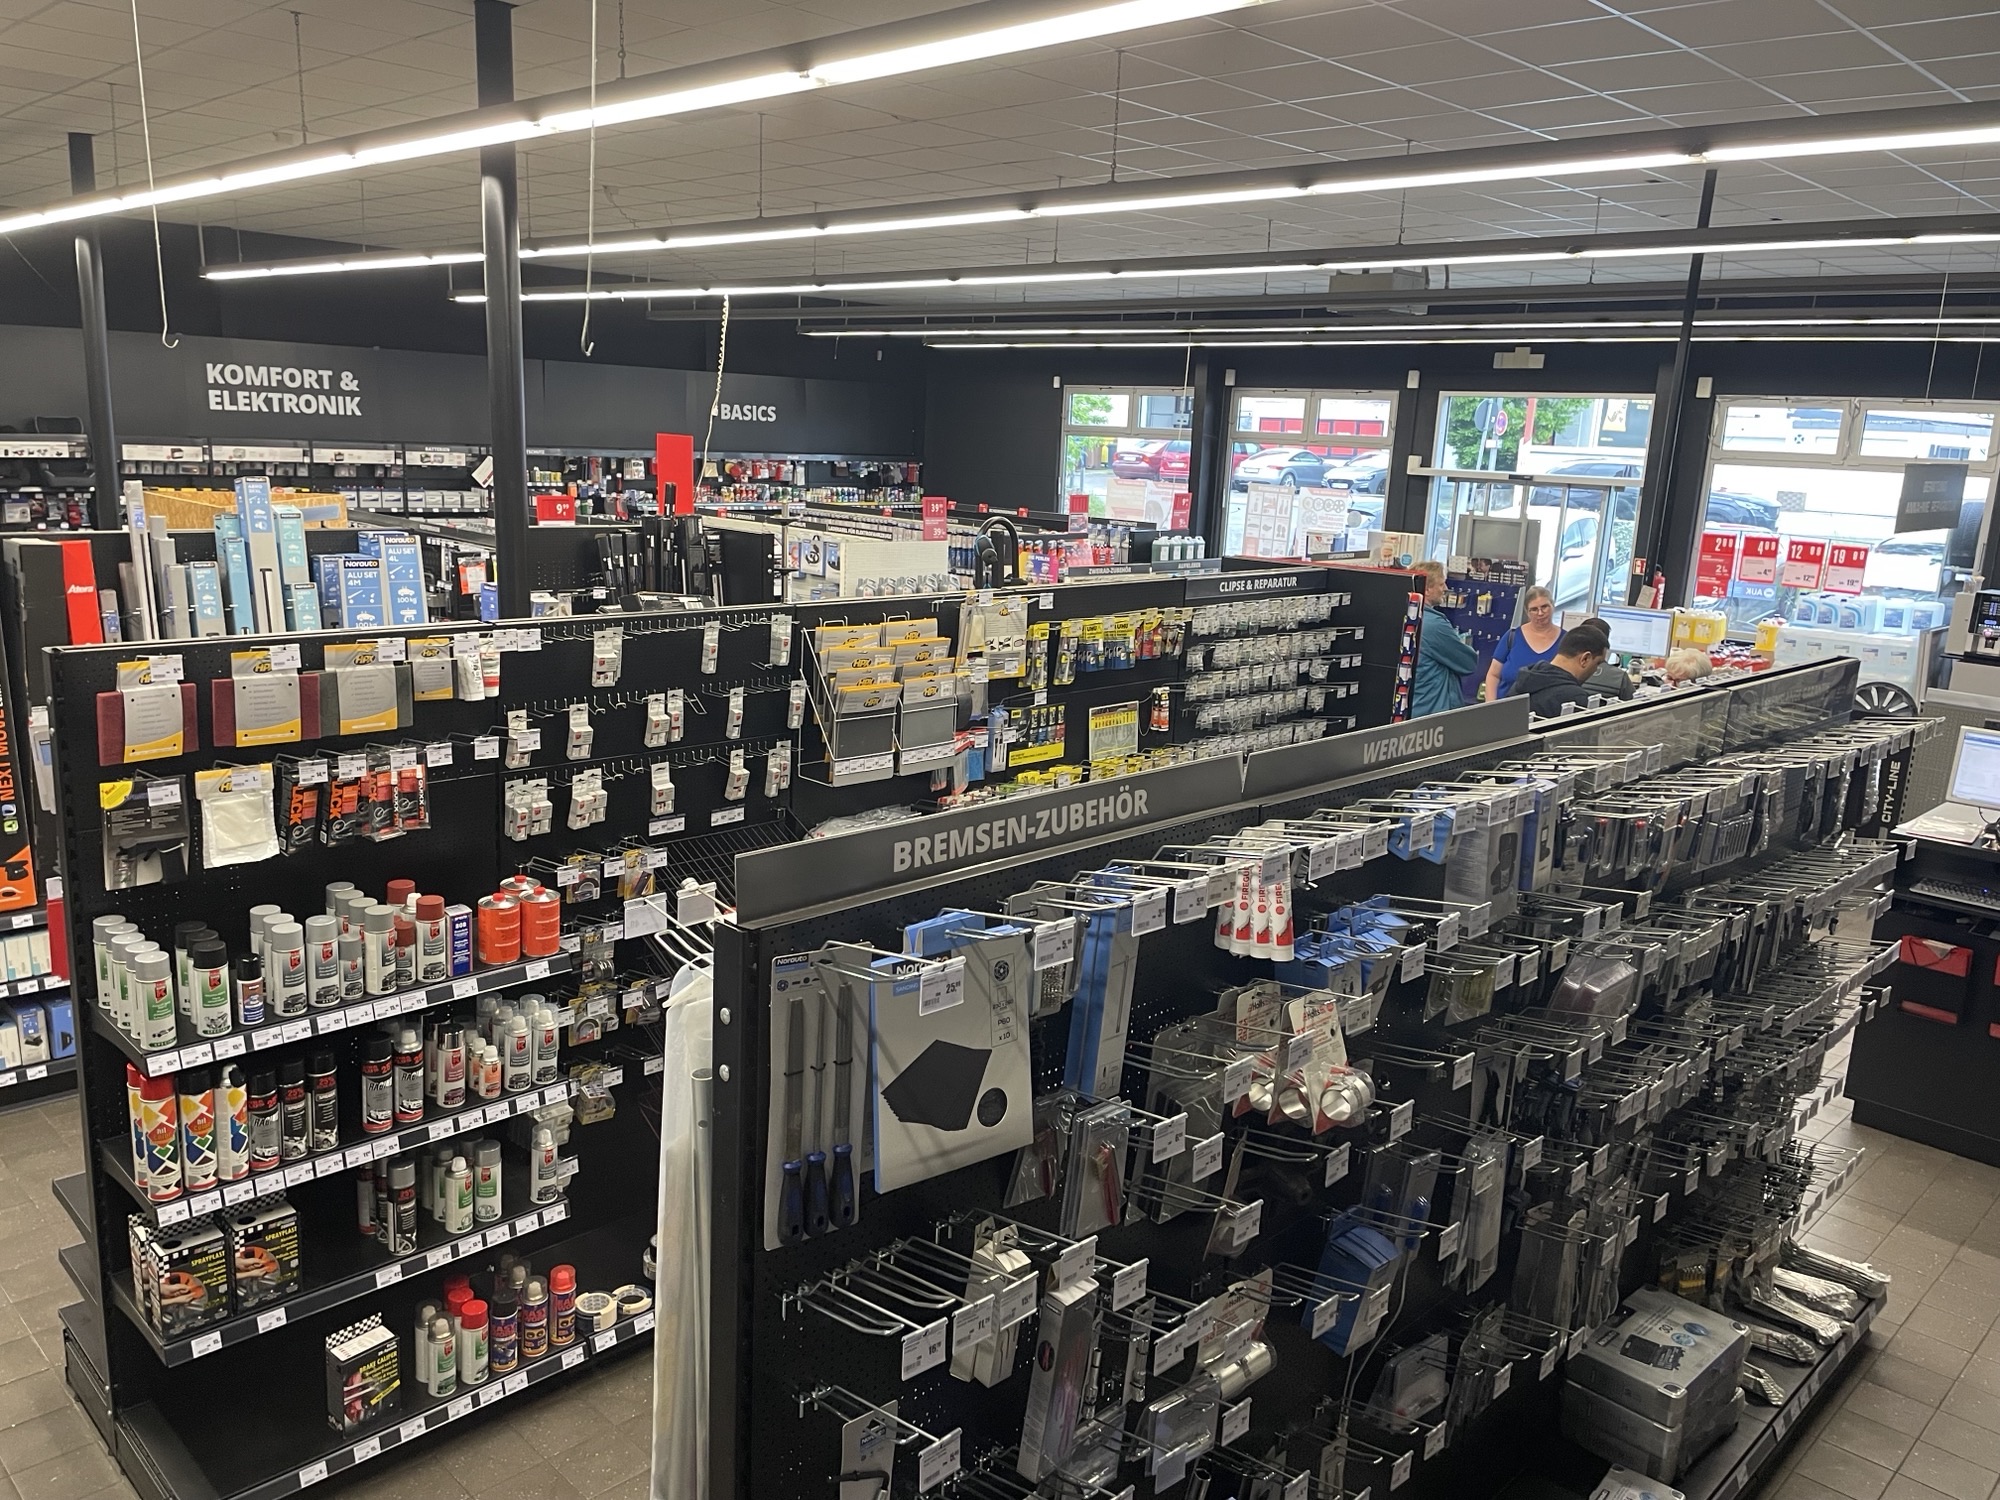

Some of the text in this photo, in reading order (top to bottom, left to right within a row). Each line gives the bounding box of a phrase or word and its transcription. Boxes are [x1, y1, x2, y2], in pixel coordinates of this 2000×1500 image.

[206, 363, 360, 391] KOMFORT &
[208, 388, 362, 416] ELEKTRONIK
[720, 403, 777, 423] BASICS
[1219, 576, 1298, 593] CLIPSE & REPARATUR
[852, 658, 872, 668] HPX
[1363, 726, 1444, 764] WERKZEUG
[1882, 760, 1901, 823] CITY-LINE
[893, 785, 1149, 873] BREMSEN-ZUBEHÖR
[777, 954, 807, 965] Norauto
[265, 1226, 298, 1242] SPRAYPLAST
[191, 1250, 225, 1267] SPRAYPLAST
